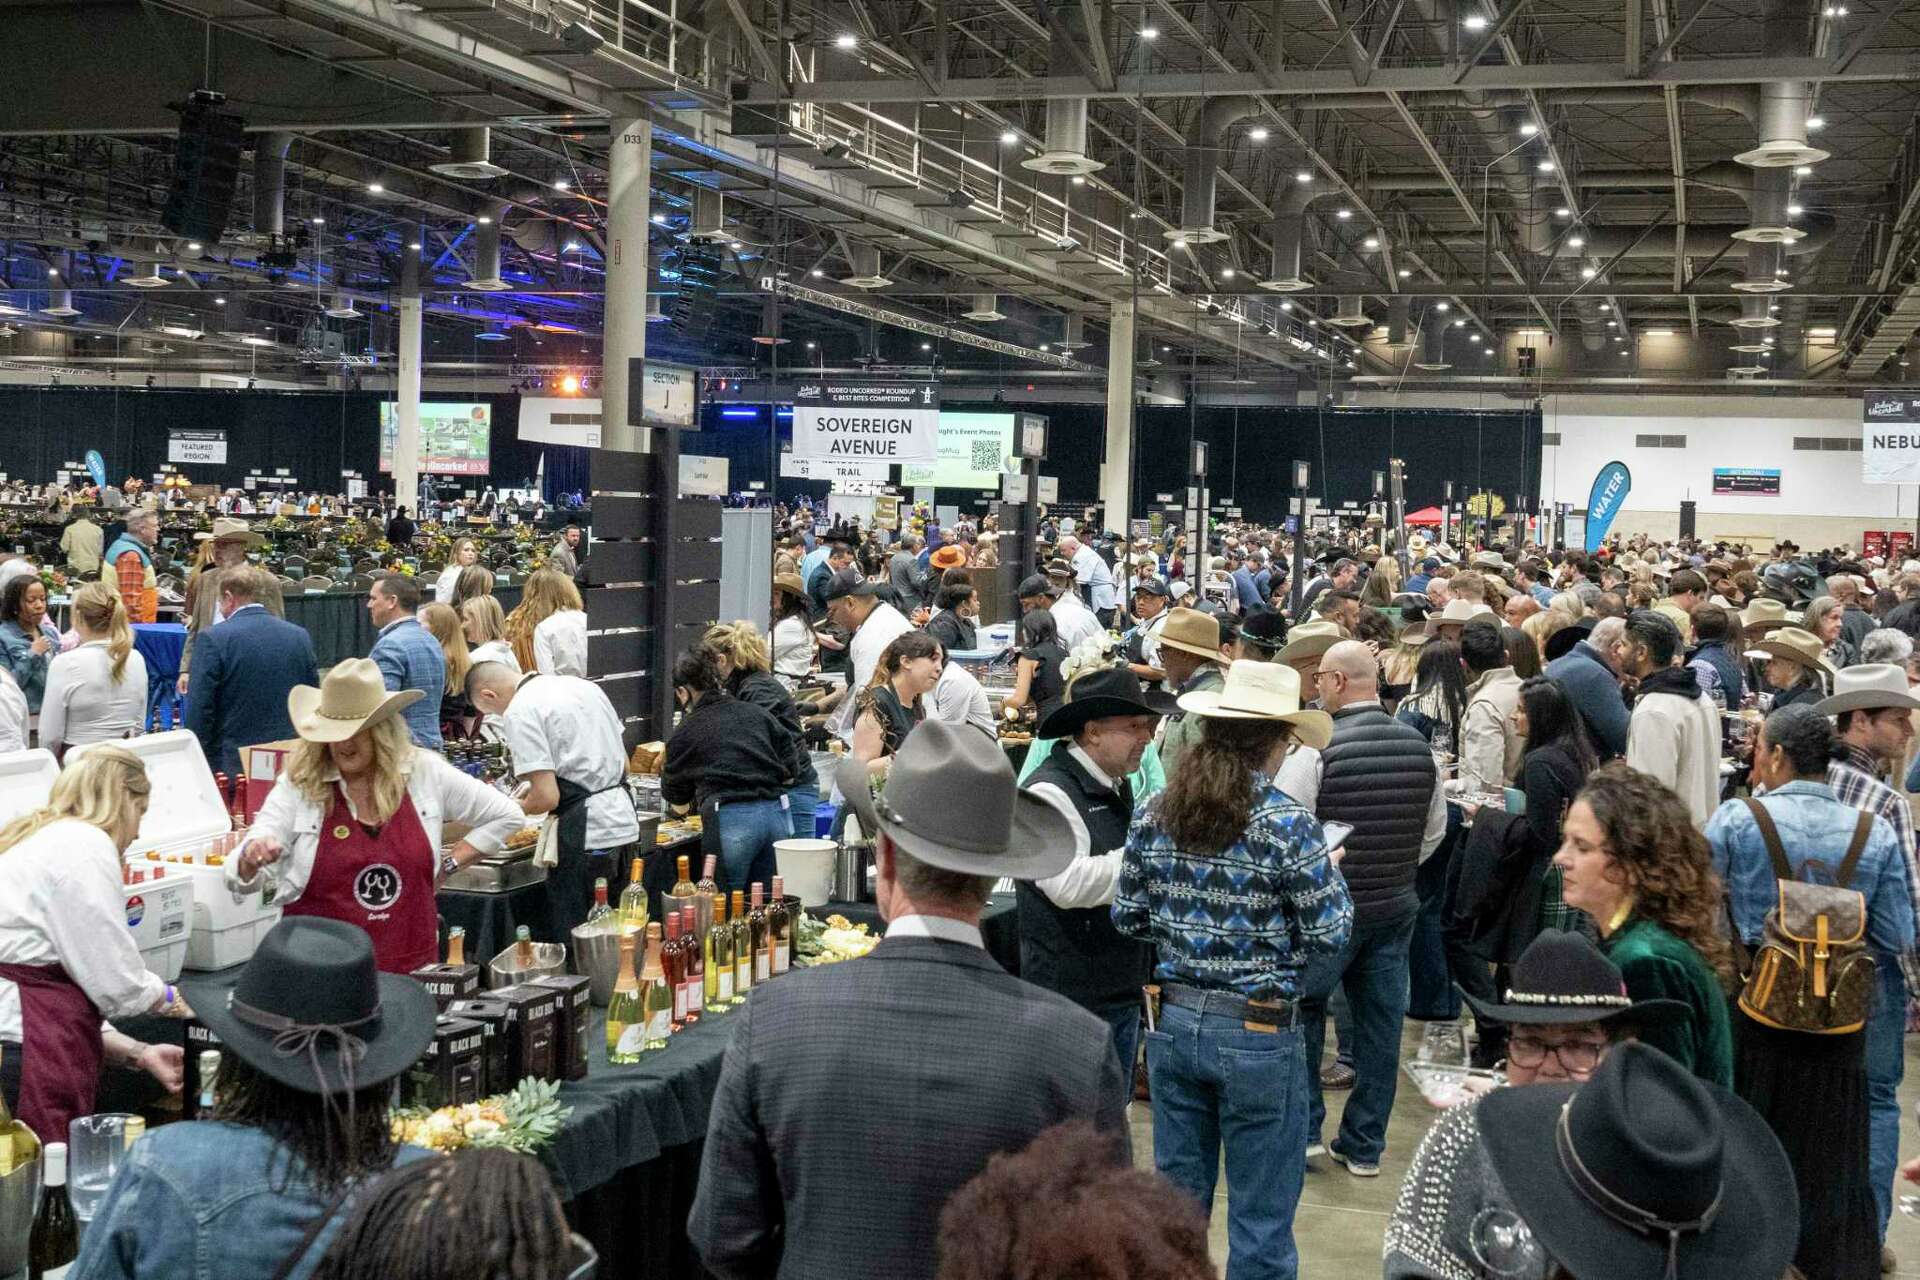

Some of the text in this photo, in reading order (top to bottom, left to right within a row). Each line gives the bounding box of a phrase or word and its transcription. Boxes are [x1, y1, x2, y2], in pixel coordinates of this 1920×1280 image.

[624, 134, 641, 144] D33
[652, 371, 680, 384] SECTION
[886, 387, 916, 395] ROUNDUP
[663, 389, 670, 410] J
[816, 417, 912, 434] SOVEREIGN
[830, 439, 897, 455] AVENUE
[836, 467, 862, 477] TRAIL
[1592, 471, 1625, 520] WATER
[440, 983, 455, 995] BOX
[528, 1002, 555, 1021] BLACK BOX
[450, 1033, 482, 1054] BLACK BOX
